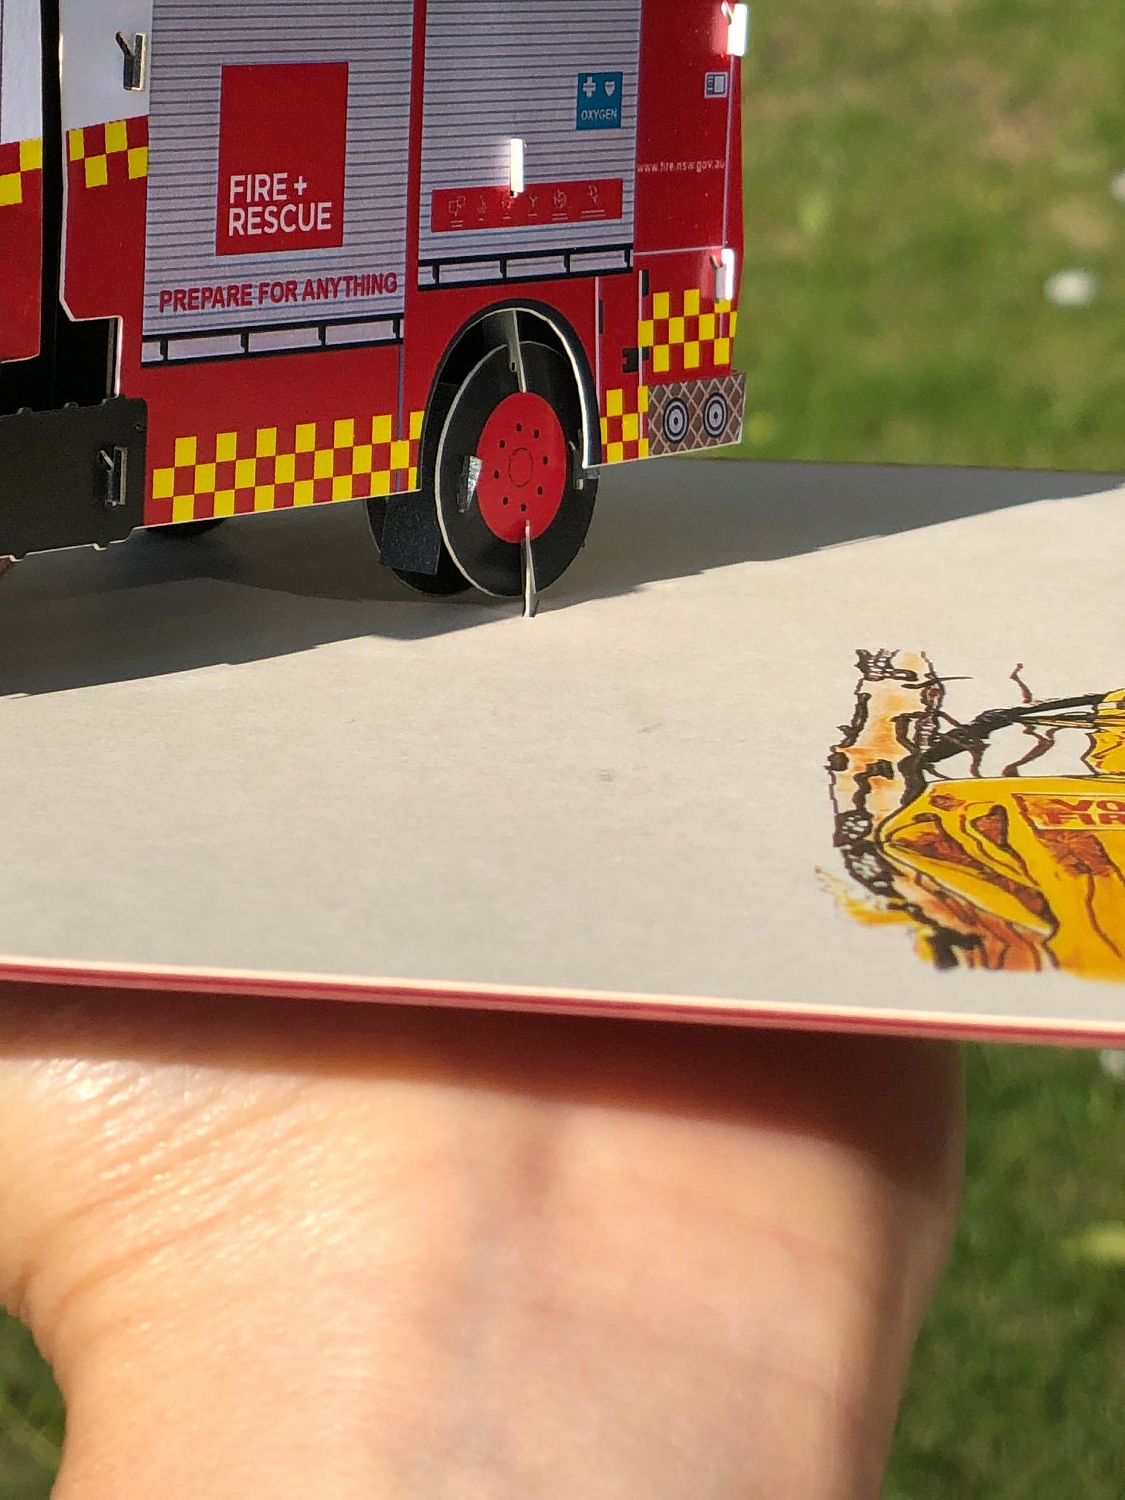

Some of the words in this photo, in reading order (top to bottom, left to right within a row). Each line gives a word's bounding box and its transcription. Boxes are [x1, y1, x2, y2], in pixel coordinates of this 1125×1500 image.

[581, 109, 618, 121] OXYGEN
[229, 173, 288, 204] FIRE
[228, 202, 332, 237] RESCUE
[159, 284, 252, 313] PREPARE
[258, 278, 298, 304] FOR
[302, 272, 398, 301] ANYTHING
